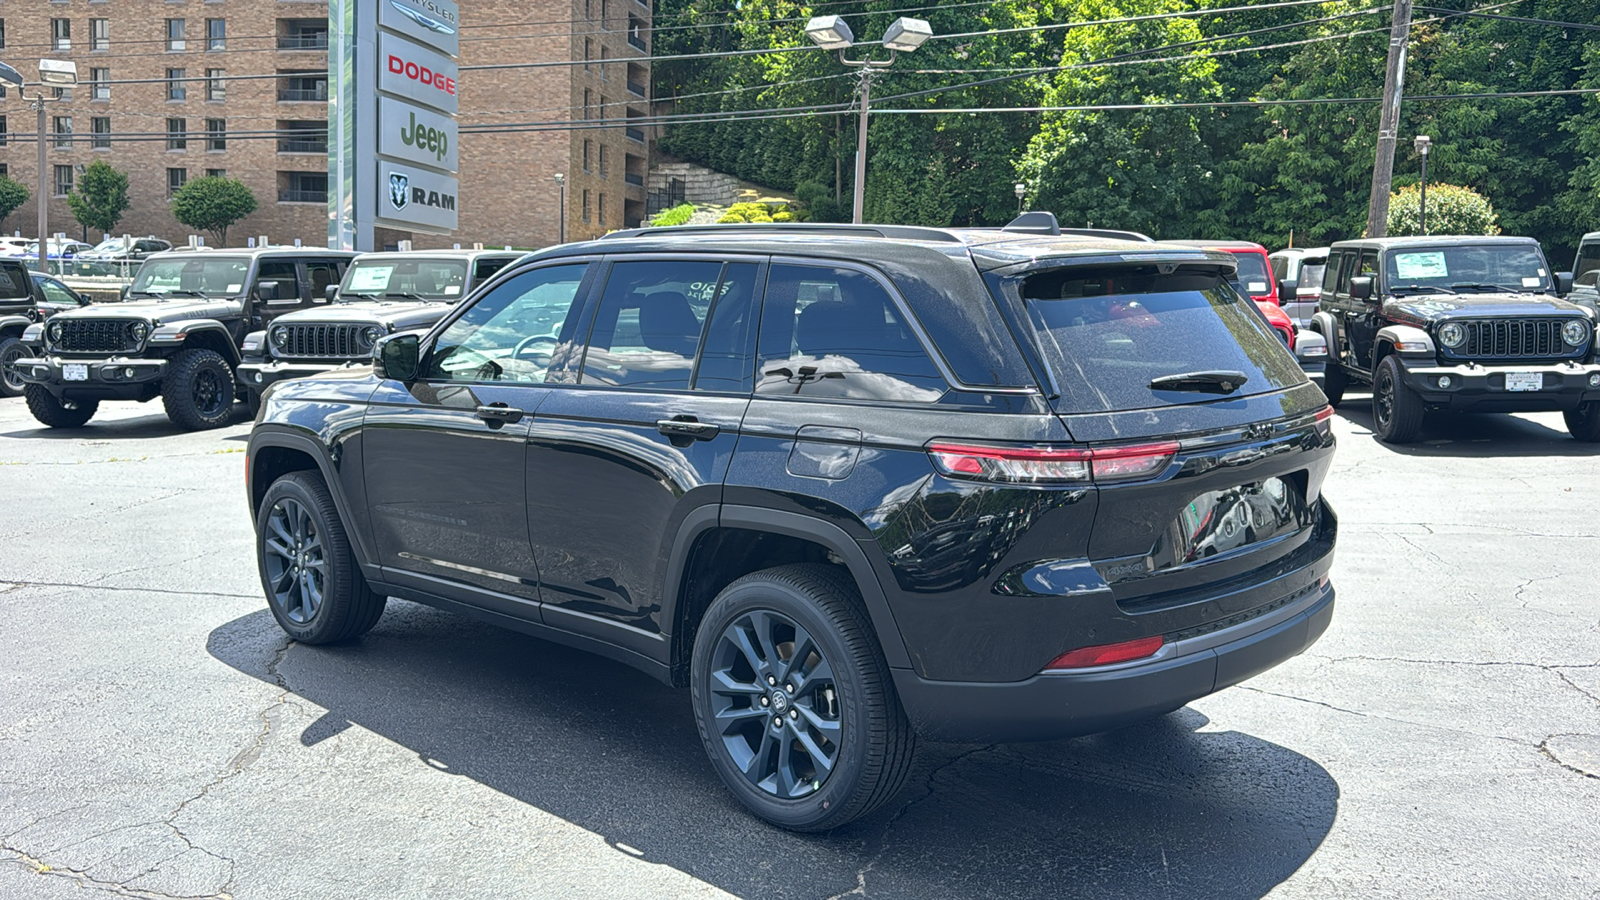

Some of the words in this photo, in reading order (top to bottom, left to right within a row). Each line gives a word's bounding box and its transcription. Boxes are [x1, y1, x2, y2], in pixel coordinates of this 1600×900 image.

[388, 55, 455, 95] DODGE
[401, 111, 448, 161] Jeep
[411, 187, 455, 211] RAM
